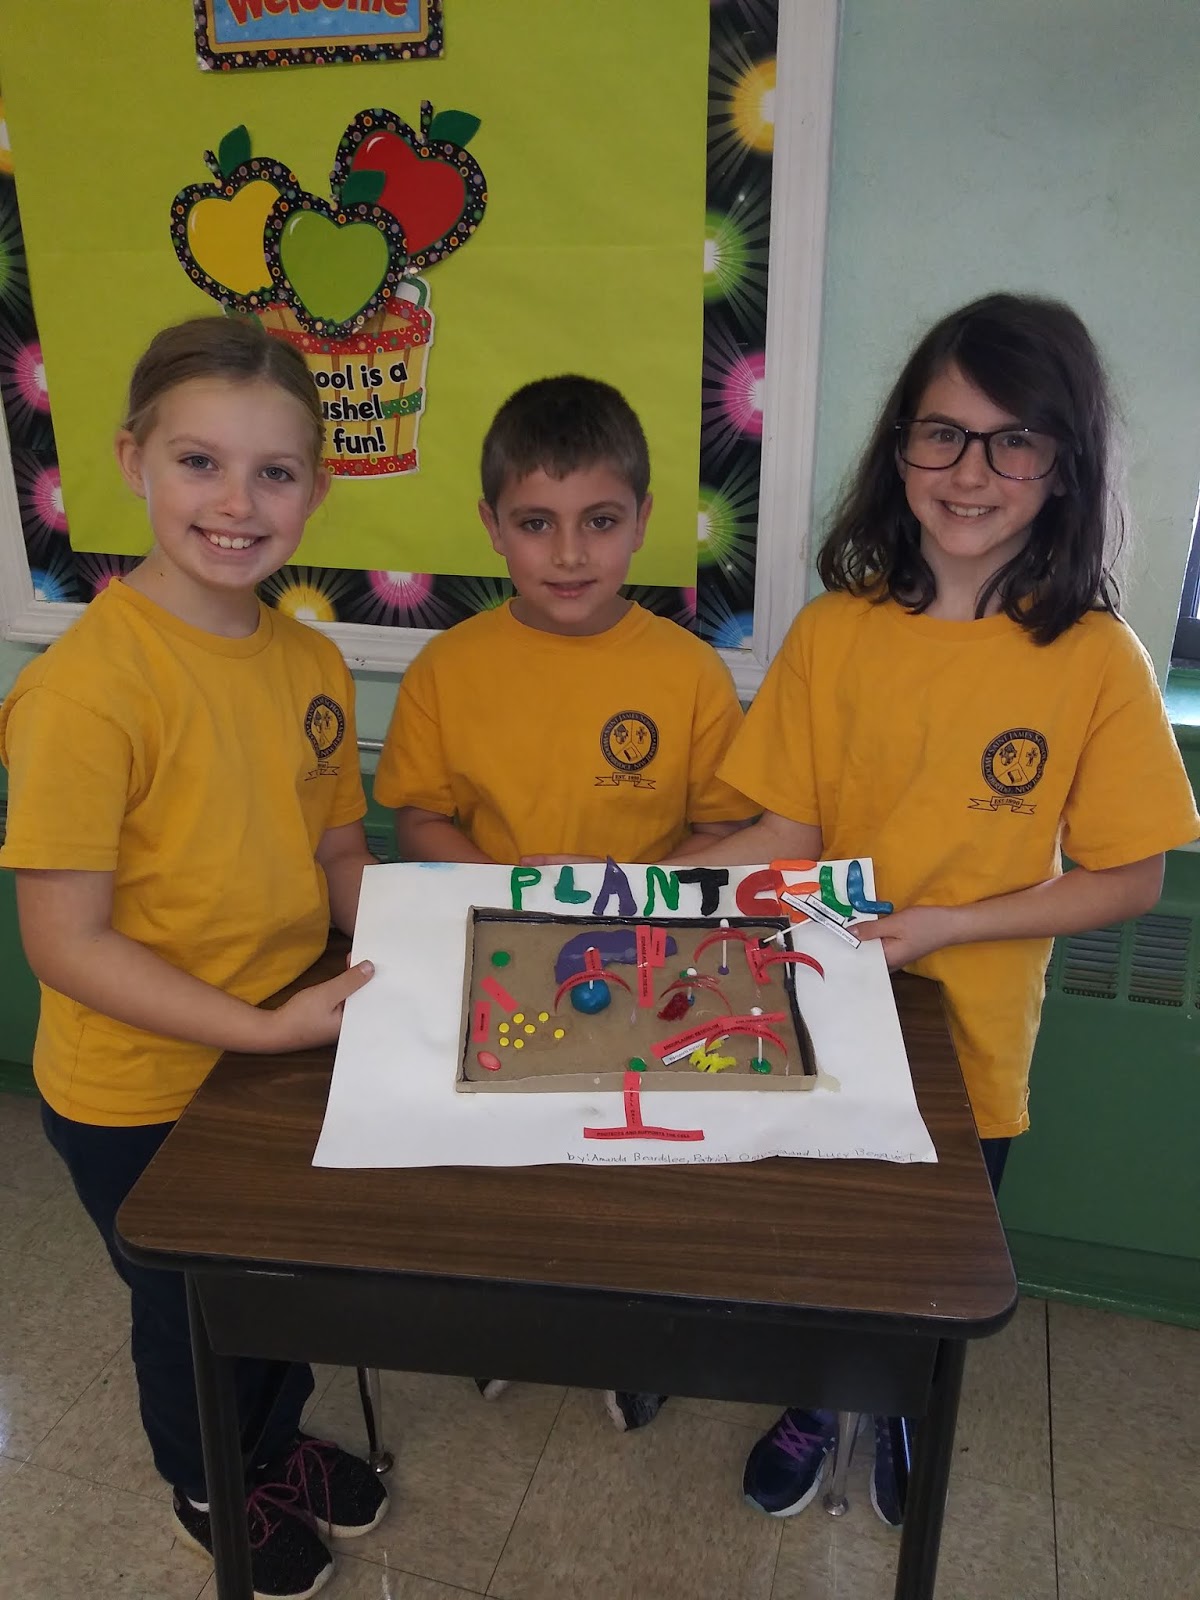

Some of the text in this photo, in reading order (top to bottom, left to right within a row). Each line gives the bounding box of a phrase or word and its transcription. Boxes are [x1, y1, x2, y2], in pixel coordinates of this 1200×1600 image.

[314, 361, 408, 391] ool is a
[333, 426, 387, 454] fun!
[1009, 731, 1033, 740] JAMES
[510, 855, 894, 923] PLANT CELL
